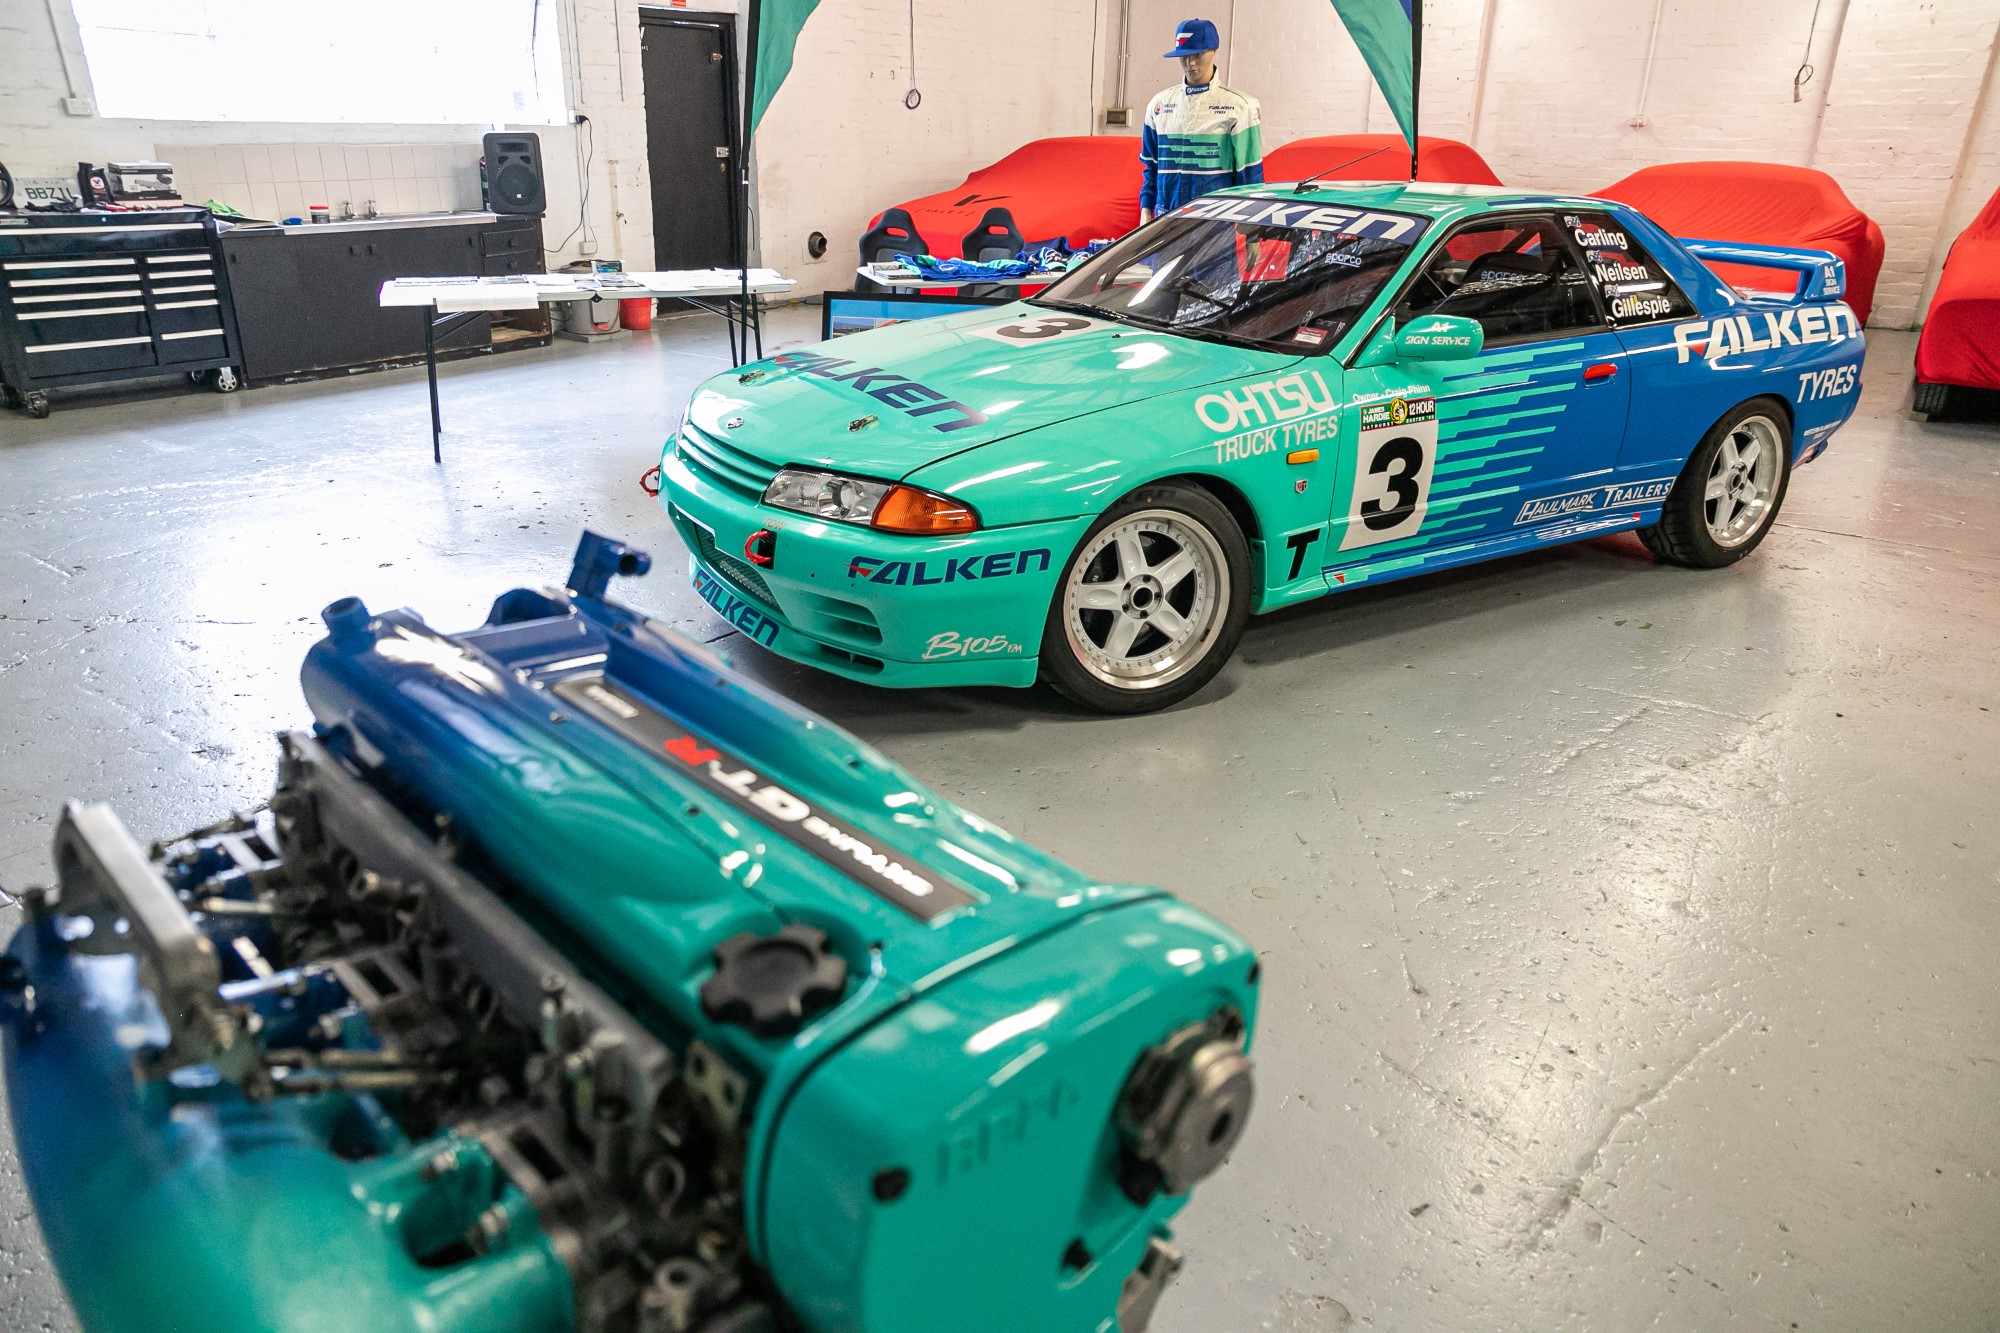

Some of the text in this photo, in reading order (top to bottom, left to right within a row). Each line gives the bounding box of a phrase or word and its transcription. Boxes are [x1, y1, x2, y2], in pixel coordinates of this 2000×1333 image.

[1168, 199, 1417, 240] FALKEN
[1574, 228, 1629, 250] Carling
[1325, 252, 1362, 266] sparco
[1594, 261, 1649, 282] Neilsen
[1824, 265, 1836, 278] A1
[1612, 295, 1671, 319] Gillespie
[996, 317, 1092, 339] 3
[1405, 335, 1472, 346] SIGN SERVICE
[1673, 306, 1857, 364] FALKEN
[757, 351, 989, 433] FALKEN
[1385, 387, 1408, 397] Craig
[1796, 363, 1858, 404] TYRES
[1194, 370, 1335, 433] OHTSU
[1408, 400, 1434, 416] 12 HOUR
[1362, 411, 1390, 424] HARDIE
[1362, 421, 1394, 431] BATHURST
[1213, 415, 1338, 464] TRUCK TYRES
[1360, 436, 1424, 531] 3
[1520, 482, 1671, 521] HAULMARK TRAILERS
[762, 517, 788, 531] TOW
[846, 548, 1051, 586] FALKEN
[1286, 528, 1321, 582] T
[692, 568, 780, 647] FALKEN
[921, 631, 1008, 660] B105
